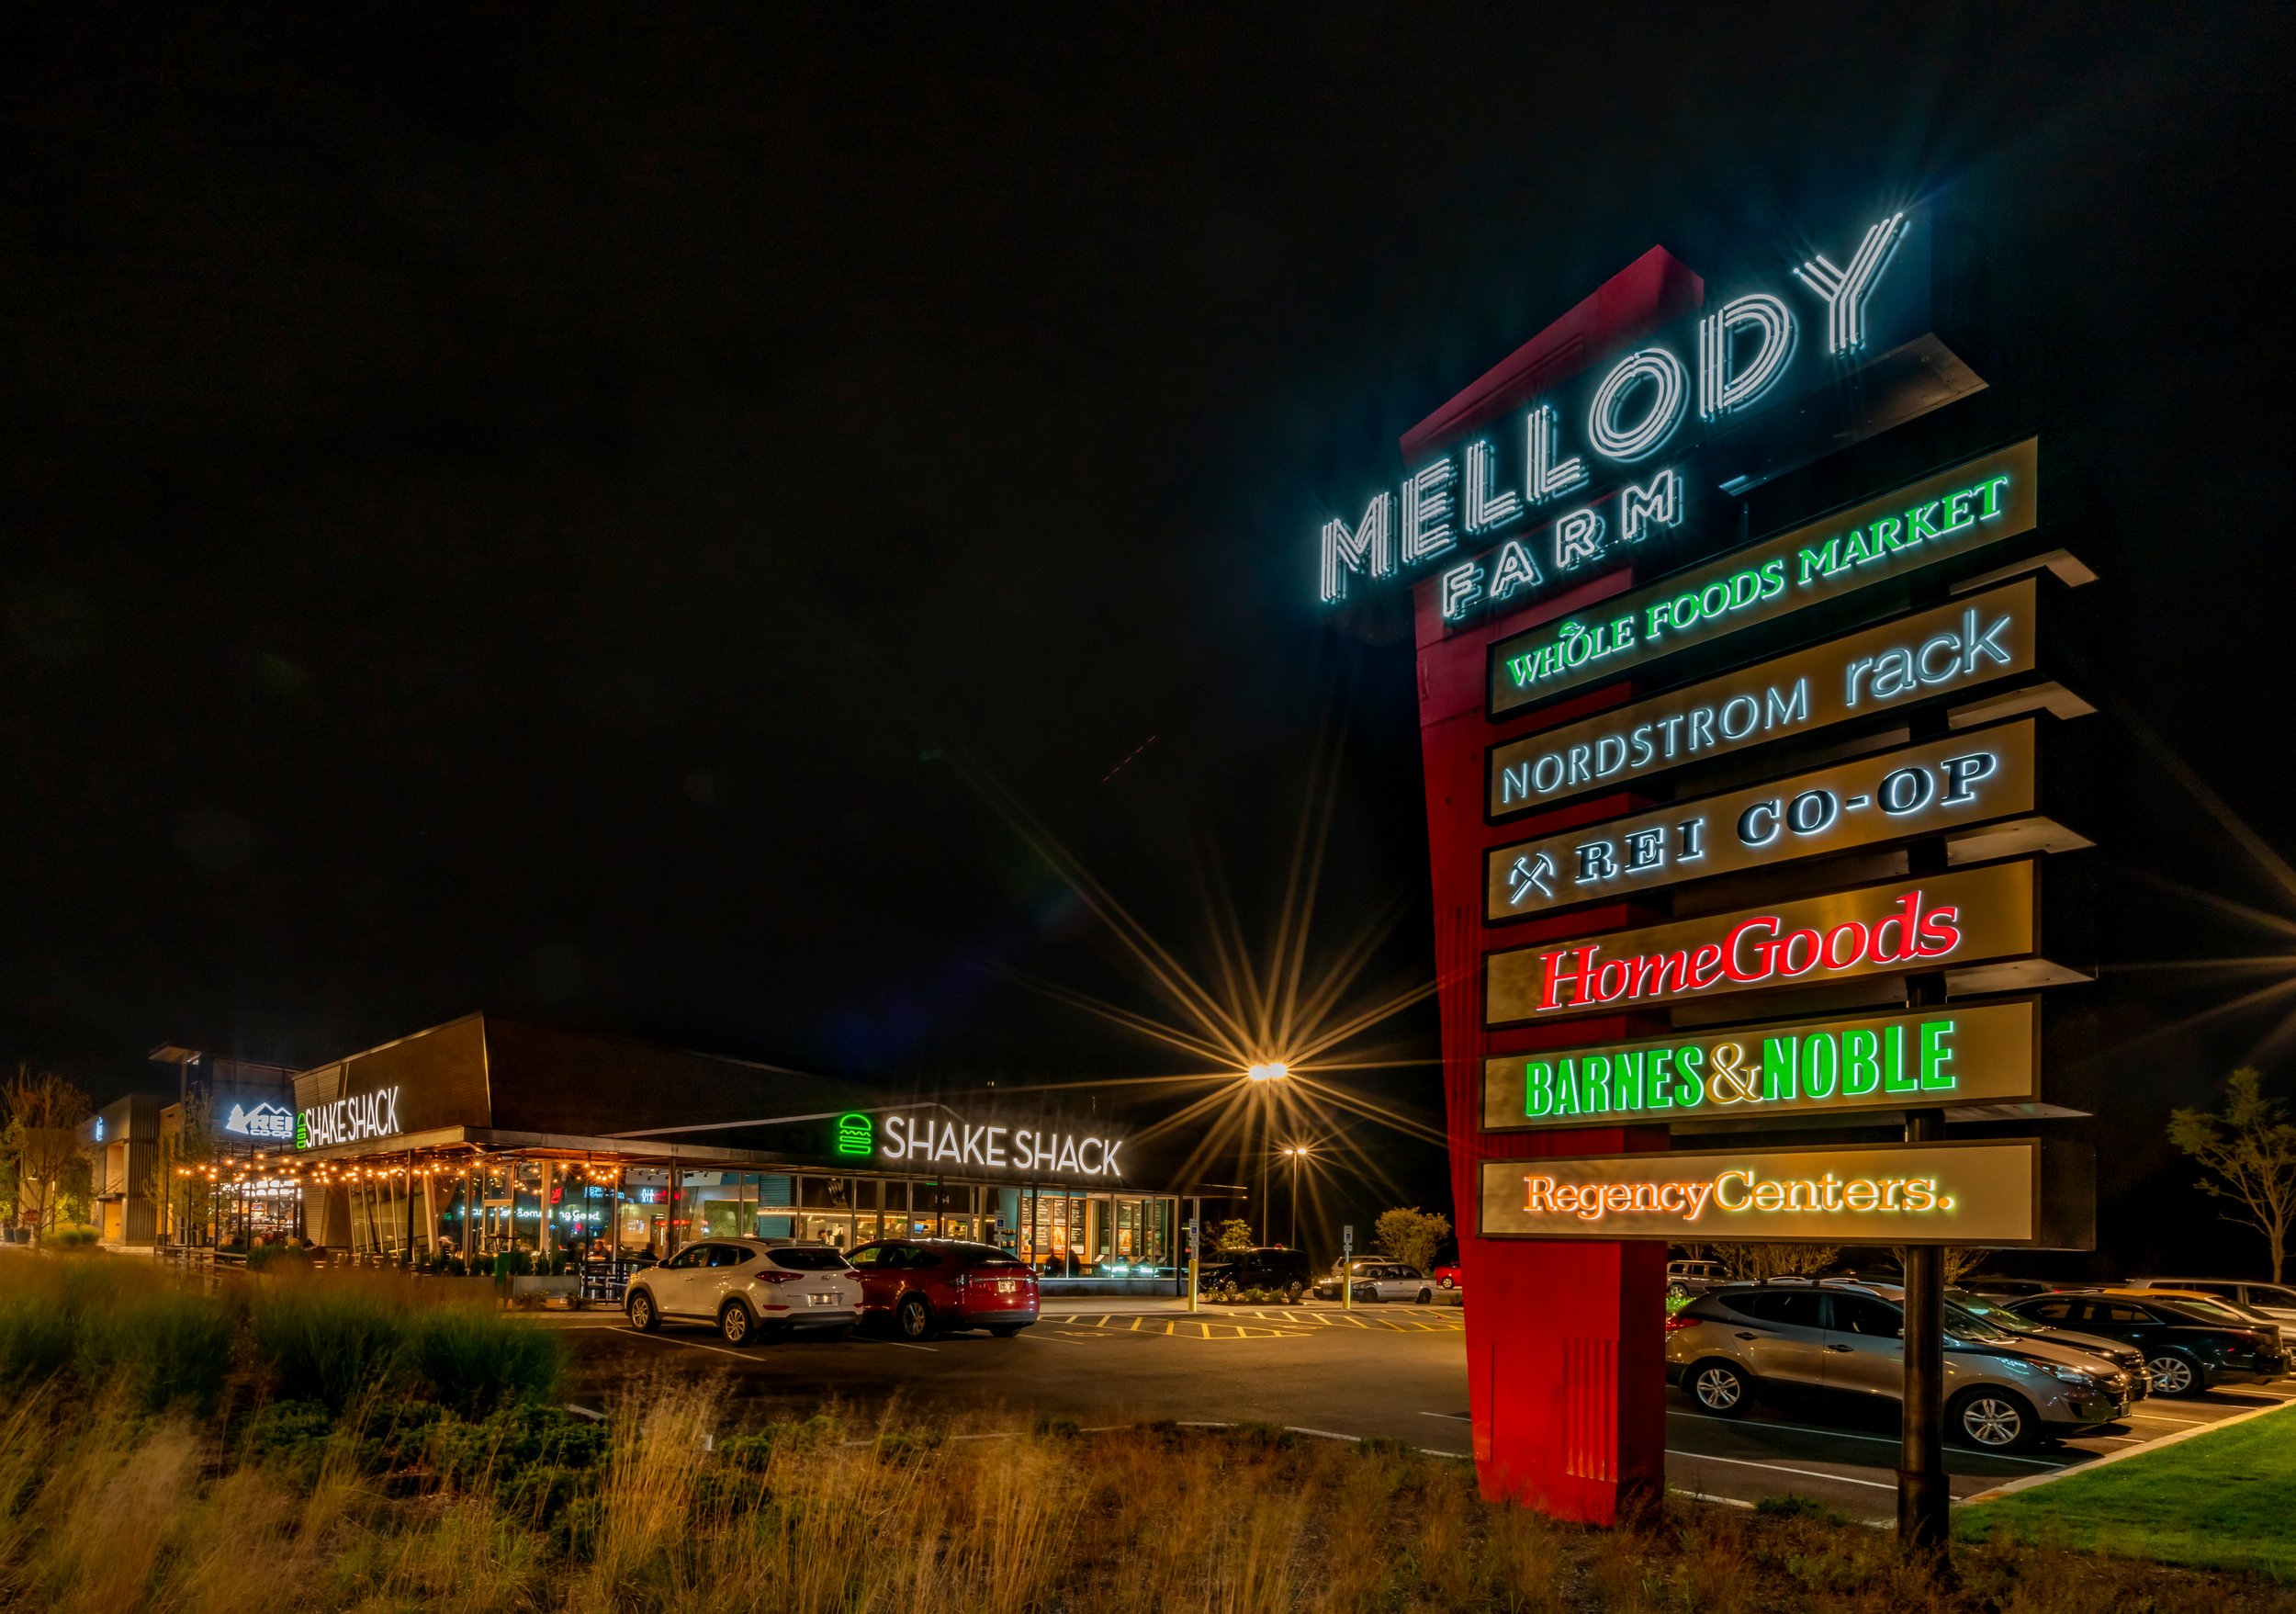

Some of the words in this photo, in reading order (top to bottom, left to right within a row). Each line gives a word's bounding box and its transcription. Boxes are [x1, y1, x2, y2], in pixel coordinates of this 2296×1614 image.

[1320, 212, 1904, 602] MELLODY
[1442, 469, 1679, 618] FARM
[1506, 615, 1636, 688] WHOLE
[1646, 559, 1784, 639] FOODS
[1797, 474, 2009, 586] MARKET
[1502, 679, 1807, 804] NORDSTROM
[1845, 608, 2011, 706] rack
[1575, 818, 1705, 885] REI
[1737, 751, 1997, 845] CO-OP
[1535, 889, 1962, 1011] HomeGoods
[250, 1114, 293, 1131] REI
[305, 1100, 347, 1148] SHAKE
[348, 1086, 400, 1141] SHACK
[882, 1115, 1007, 1167] SHAKE
[1013, 1130, 1123, 1177] SHACK
